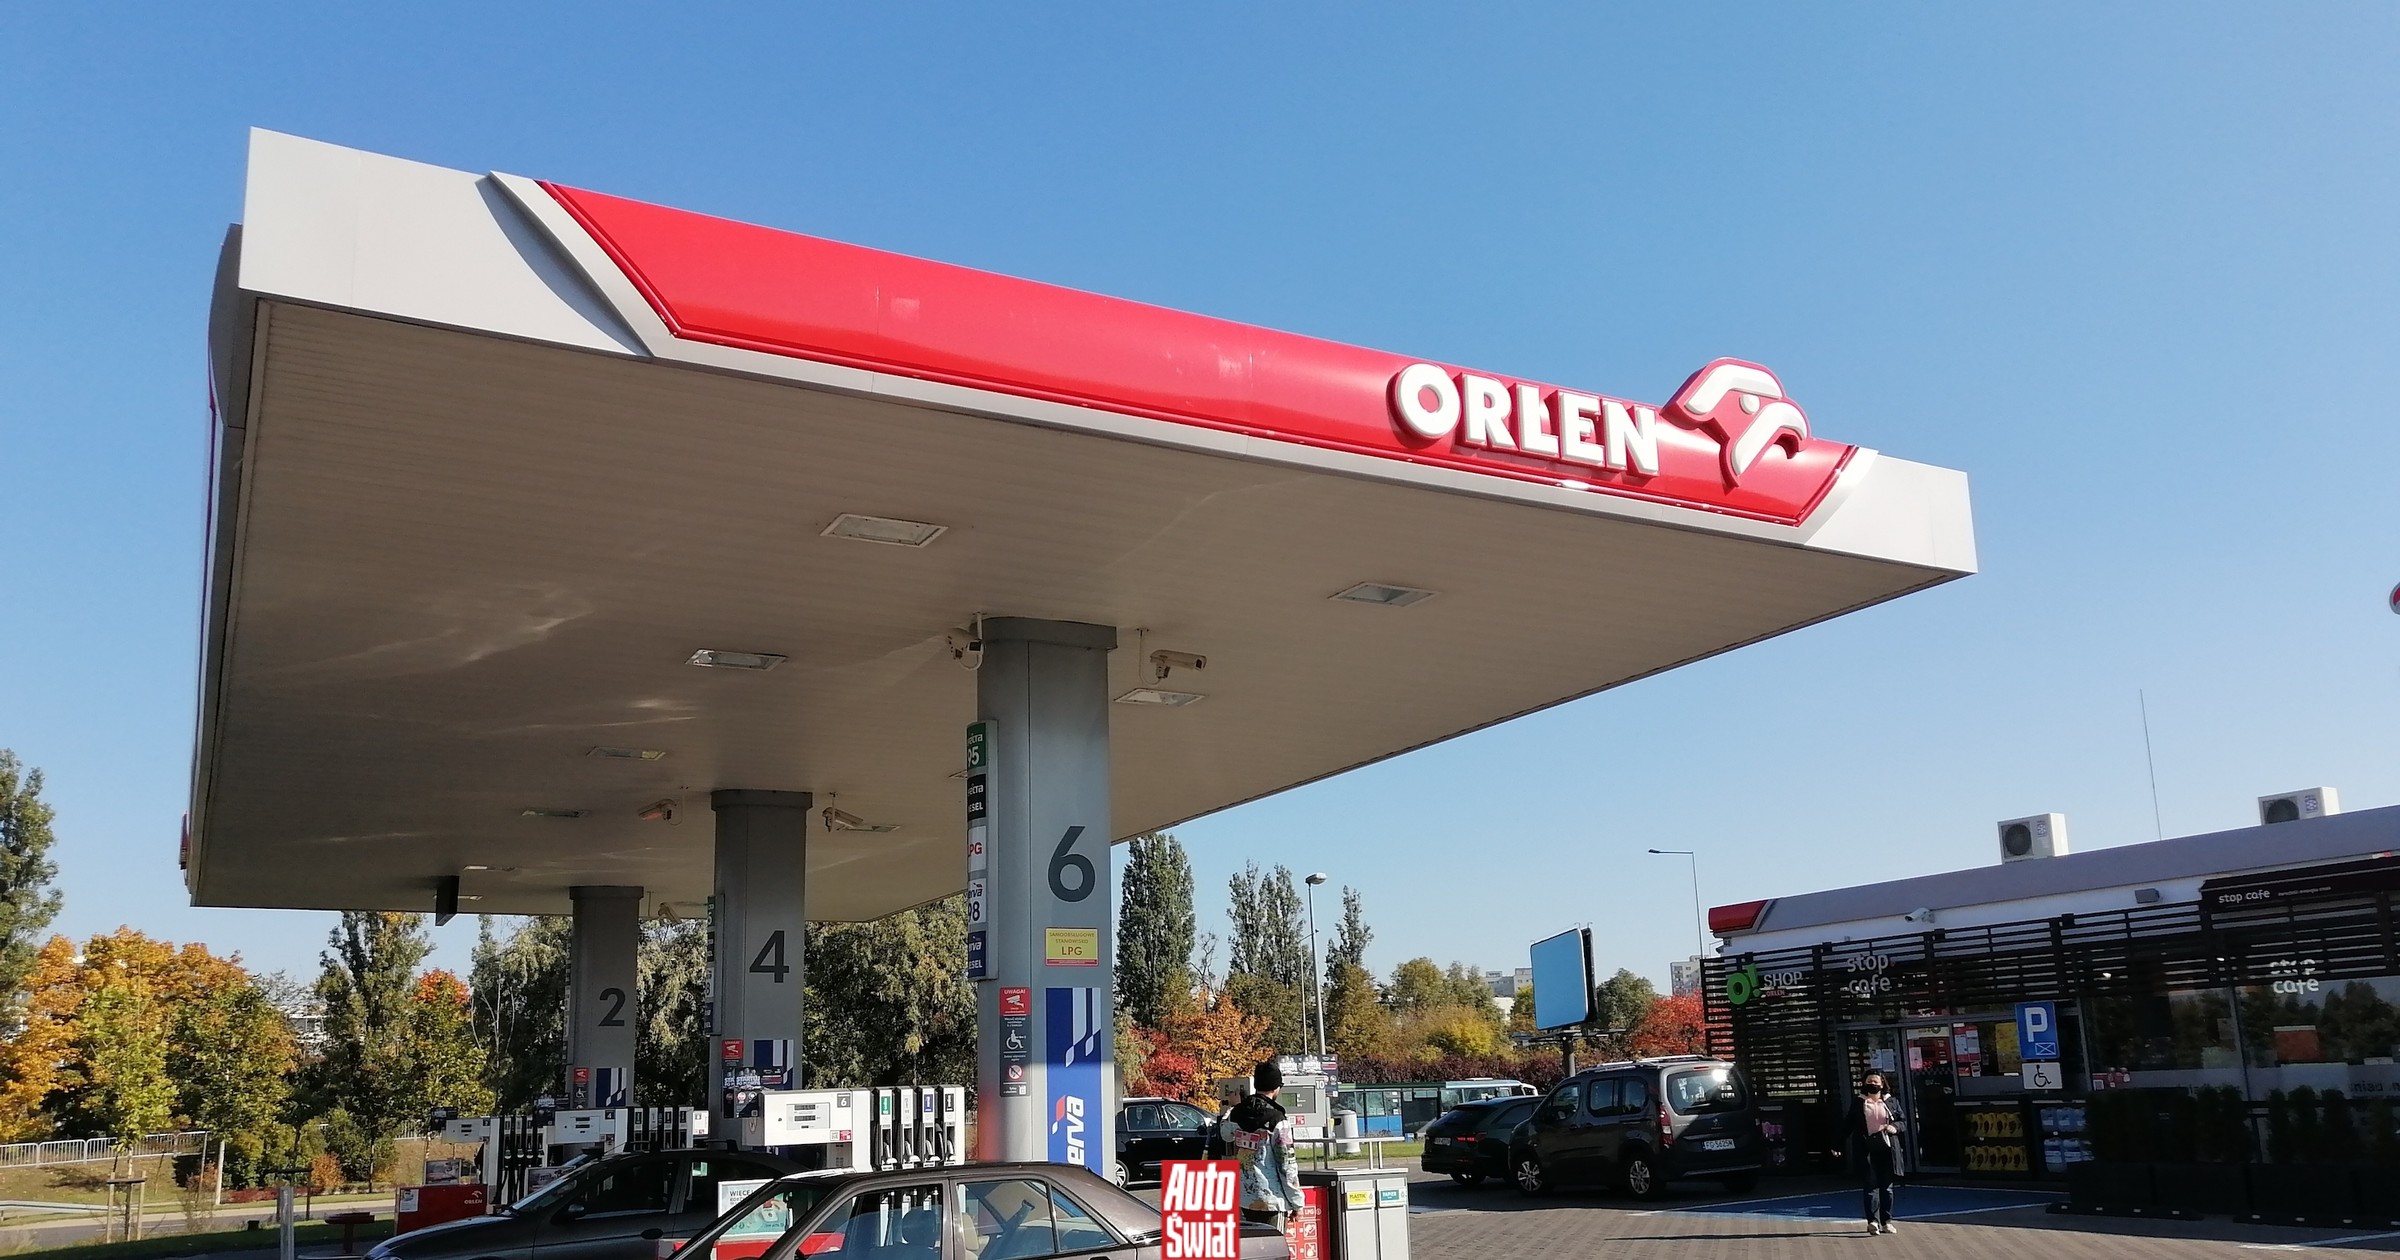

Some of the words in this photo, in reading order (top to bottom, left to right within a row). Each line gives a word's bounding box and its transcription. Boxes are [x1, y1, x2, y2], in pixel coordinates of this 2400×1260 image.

[1397, 363, 1659, 474] ORLEN
[1048, 826, 1095, 902] 6
[2219, 893, 2243, 904] stop
[2245, 889, 2271, 900] cafe
[749, 931, 789, 983] 4
[1061, 946, 1083, 956] LPG
[1764, 972, 1803, 988] SHOP
[1849, 974, 1891, 995] cafe
[598, 987, 626, 1026] 2
[2025, 1007, 2048, 1042] P
[1315, 1080, 1325, 1089] 10
[840, 1097, 847, 1106] 6
[1066, 1095, 1085, 1166] erva
